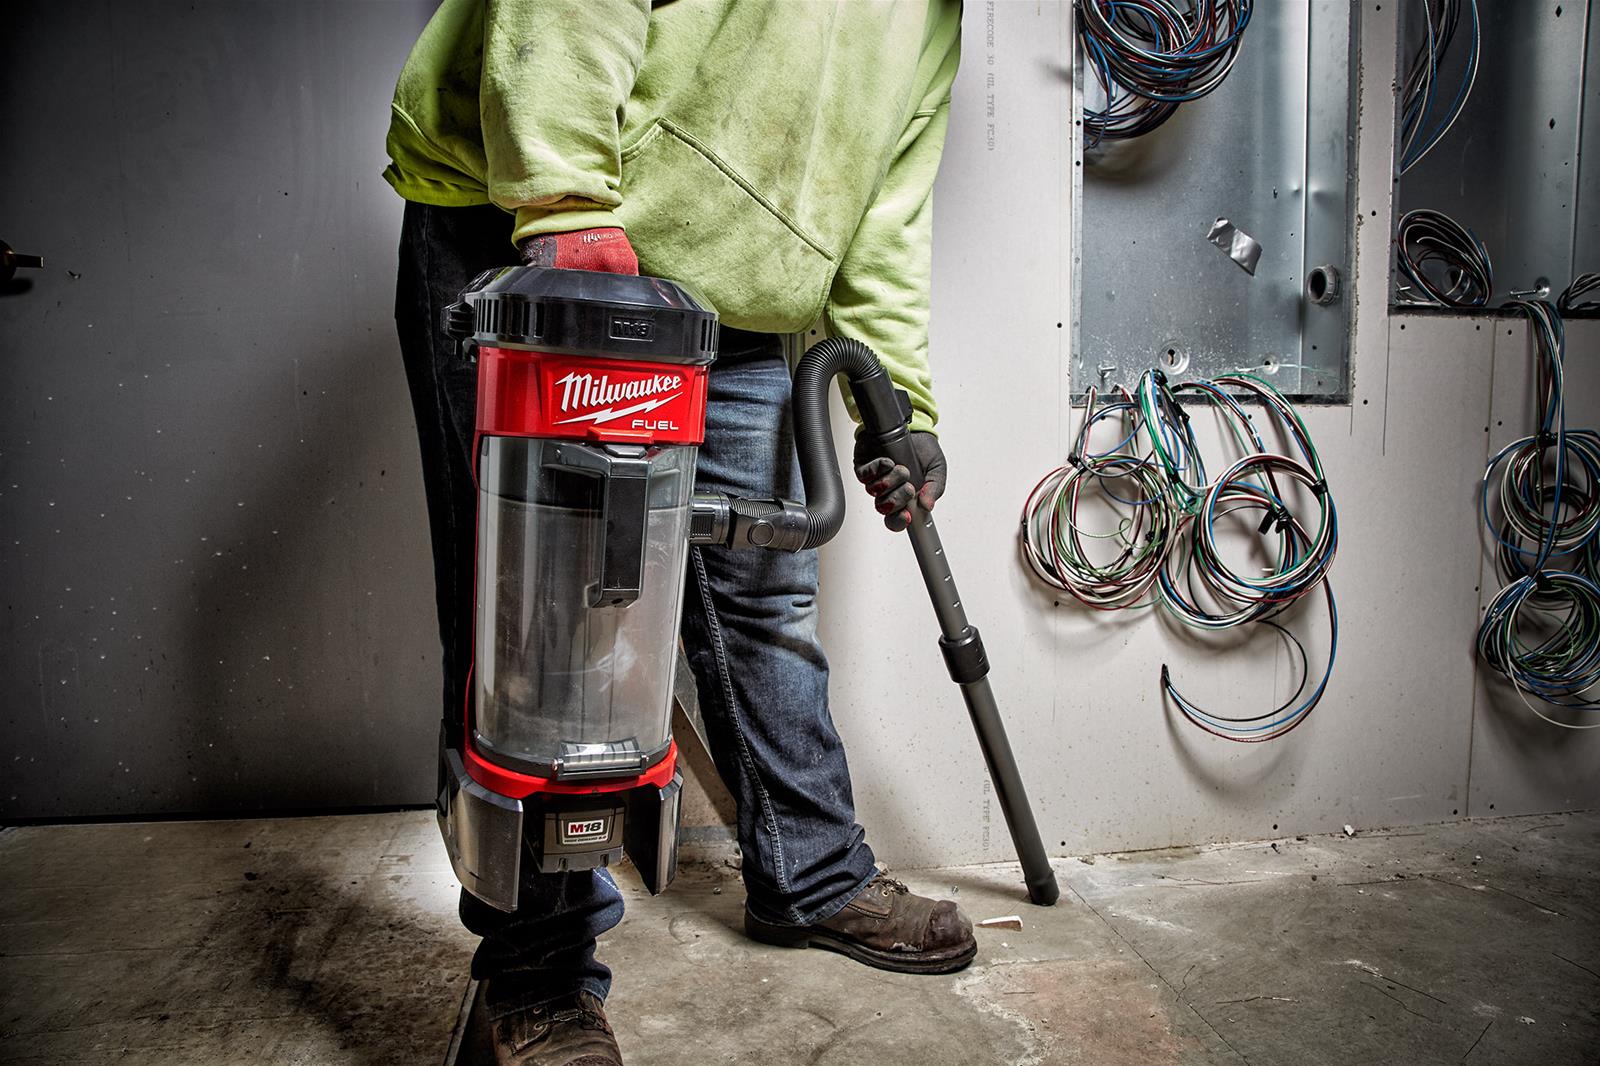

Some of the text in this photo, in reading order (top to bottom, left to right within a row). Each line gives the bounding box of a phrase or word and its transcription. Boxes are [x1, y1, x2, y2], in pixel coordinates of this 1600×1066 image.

[987, 1, 995, 48] FIRECODE
[987, 54, 995, 65] 30
[987, 94, 995, 118] TYPE
[555, 371, 682, 412] Milwaukee
[631, 419, 679, 430] FUEL
[983, 799, 991, 822] TYPE
[570, 822, 602, 833] M18
